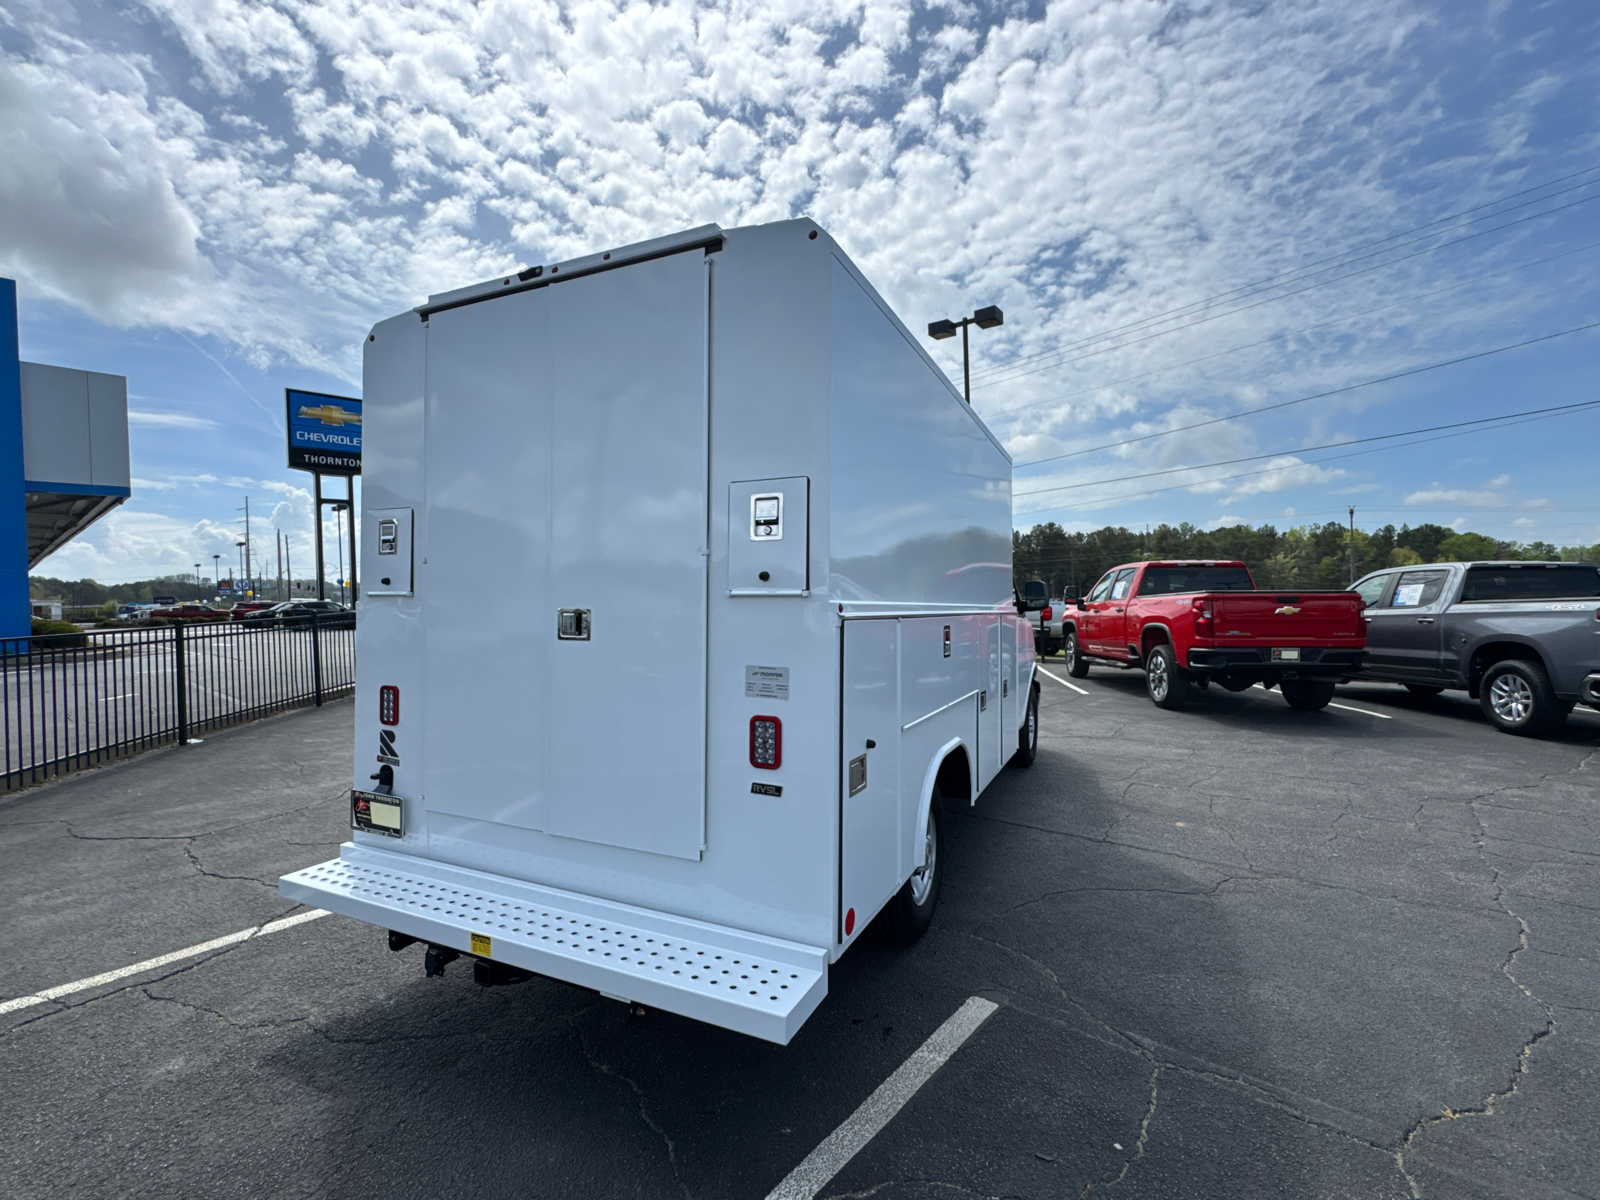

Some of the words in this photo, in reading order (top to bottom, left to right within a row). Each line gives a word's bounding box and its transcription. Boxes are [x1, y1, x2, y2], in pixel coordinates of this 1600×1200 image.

[296, 430, 362, 446] CHEVROLE
[304, 454, 362, 467] THORNTON
[753, 783, 780, 796] RVSL
